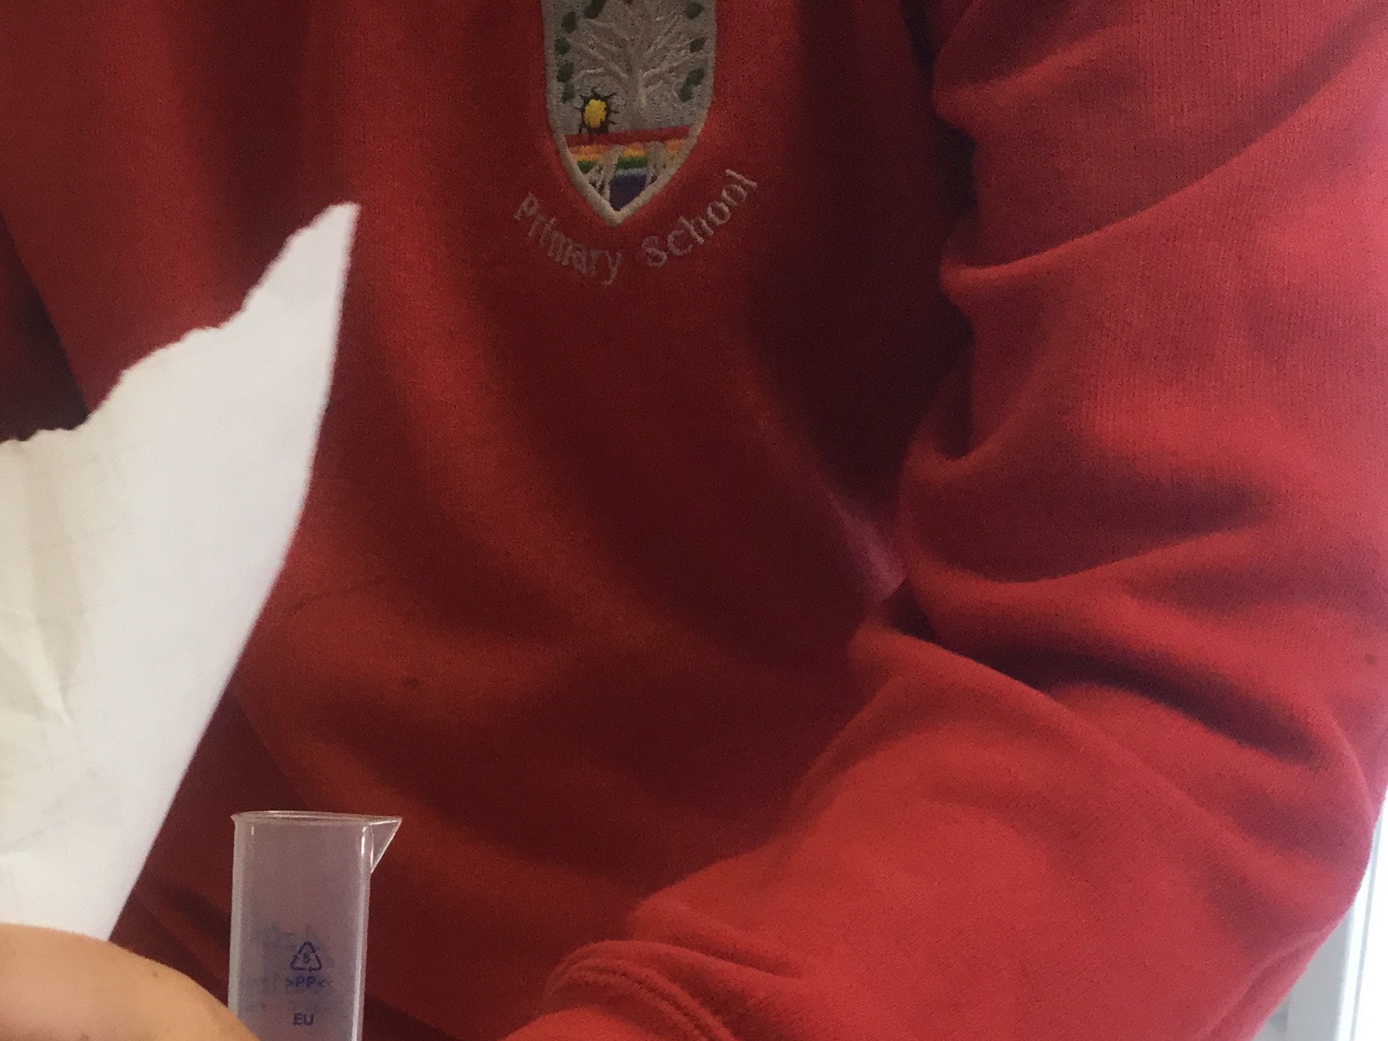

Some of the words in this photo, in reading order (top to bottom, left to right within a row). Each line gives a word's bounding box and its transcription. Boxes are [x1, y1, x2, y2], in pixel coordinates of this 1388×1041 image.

[513, 193, 623, 286] Primary
[641, 168, 758, 268] School
[292, 1012, 315, 1026] EU
